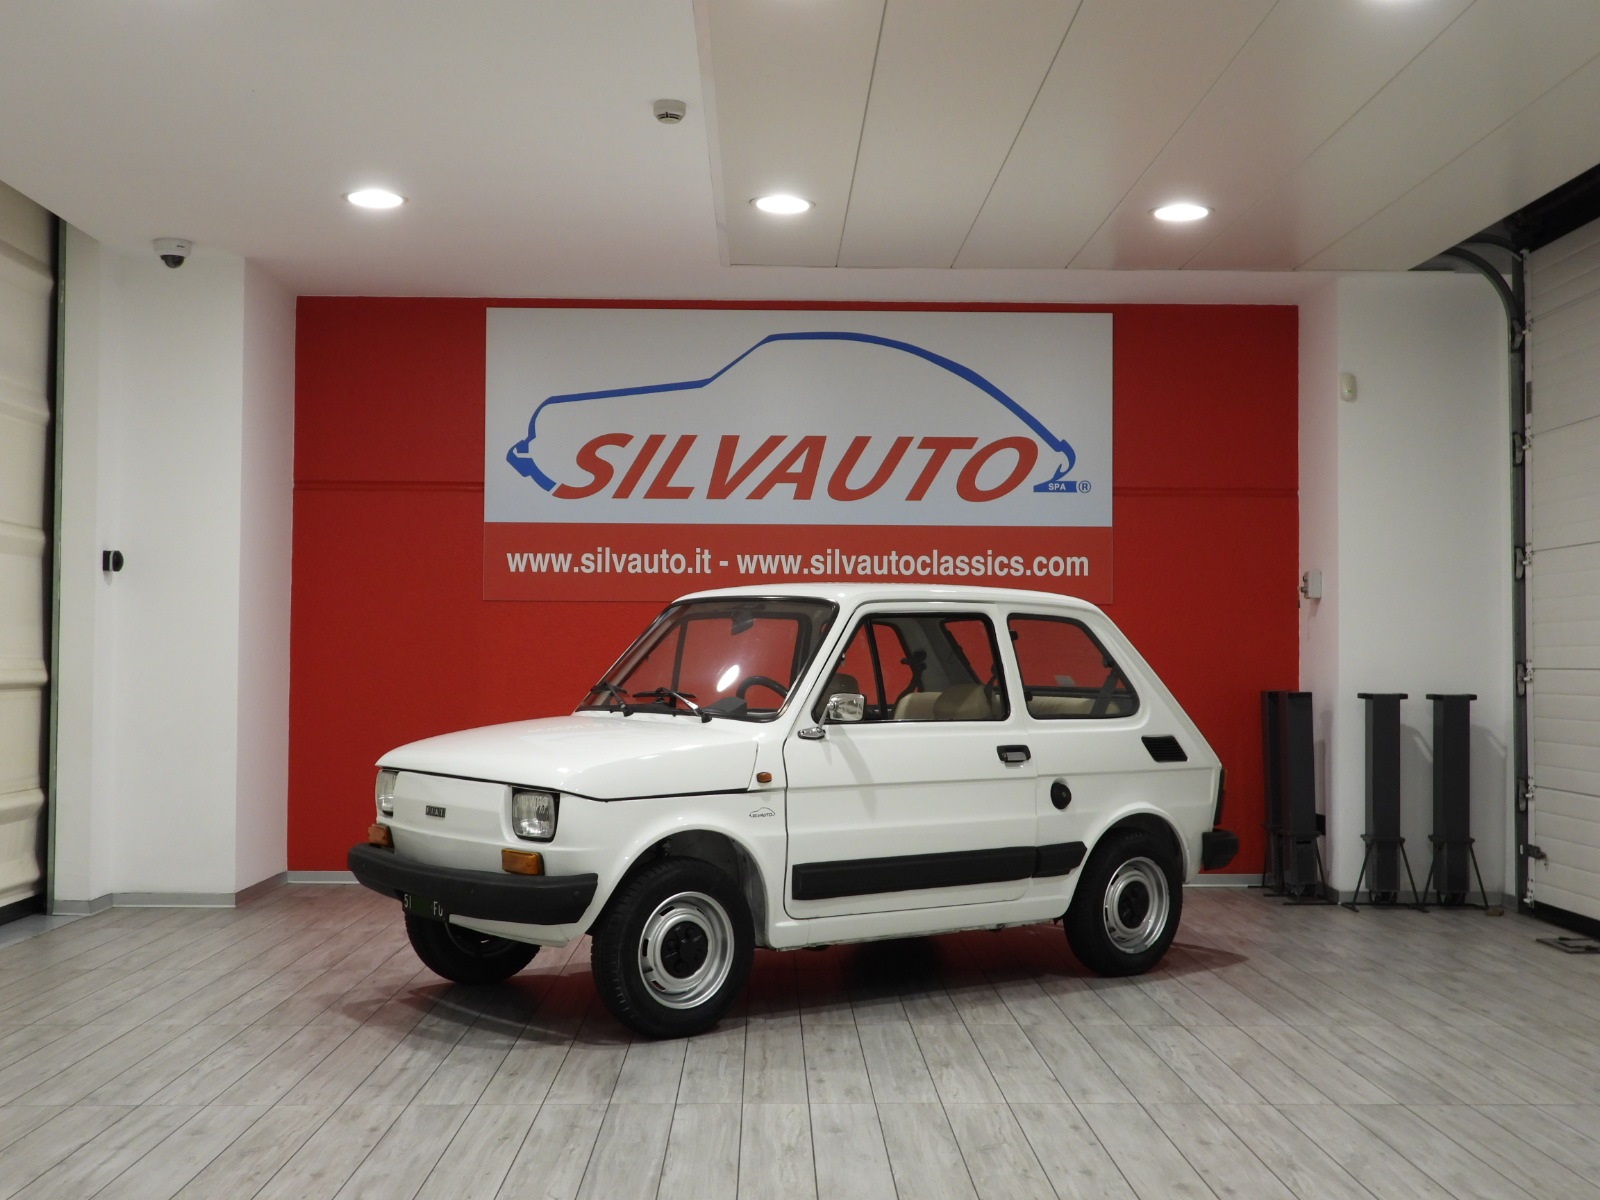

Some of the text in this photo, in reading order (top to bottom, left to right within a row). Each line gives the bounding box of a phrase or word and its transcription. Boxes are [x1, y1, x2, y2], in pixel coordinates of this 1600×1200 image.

[553, 432, 1039, 503] SILVAUTO
[1048, 482, 1067, 491] SPA
[506, 546, 712, 574] www.silvauto.it
[736, 548, 1089, 577] www.silvautoclassics.com
[425, 805, 445, 817] FIAT
